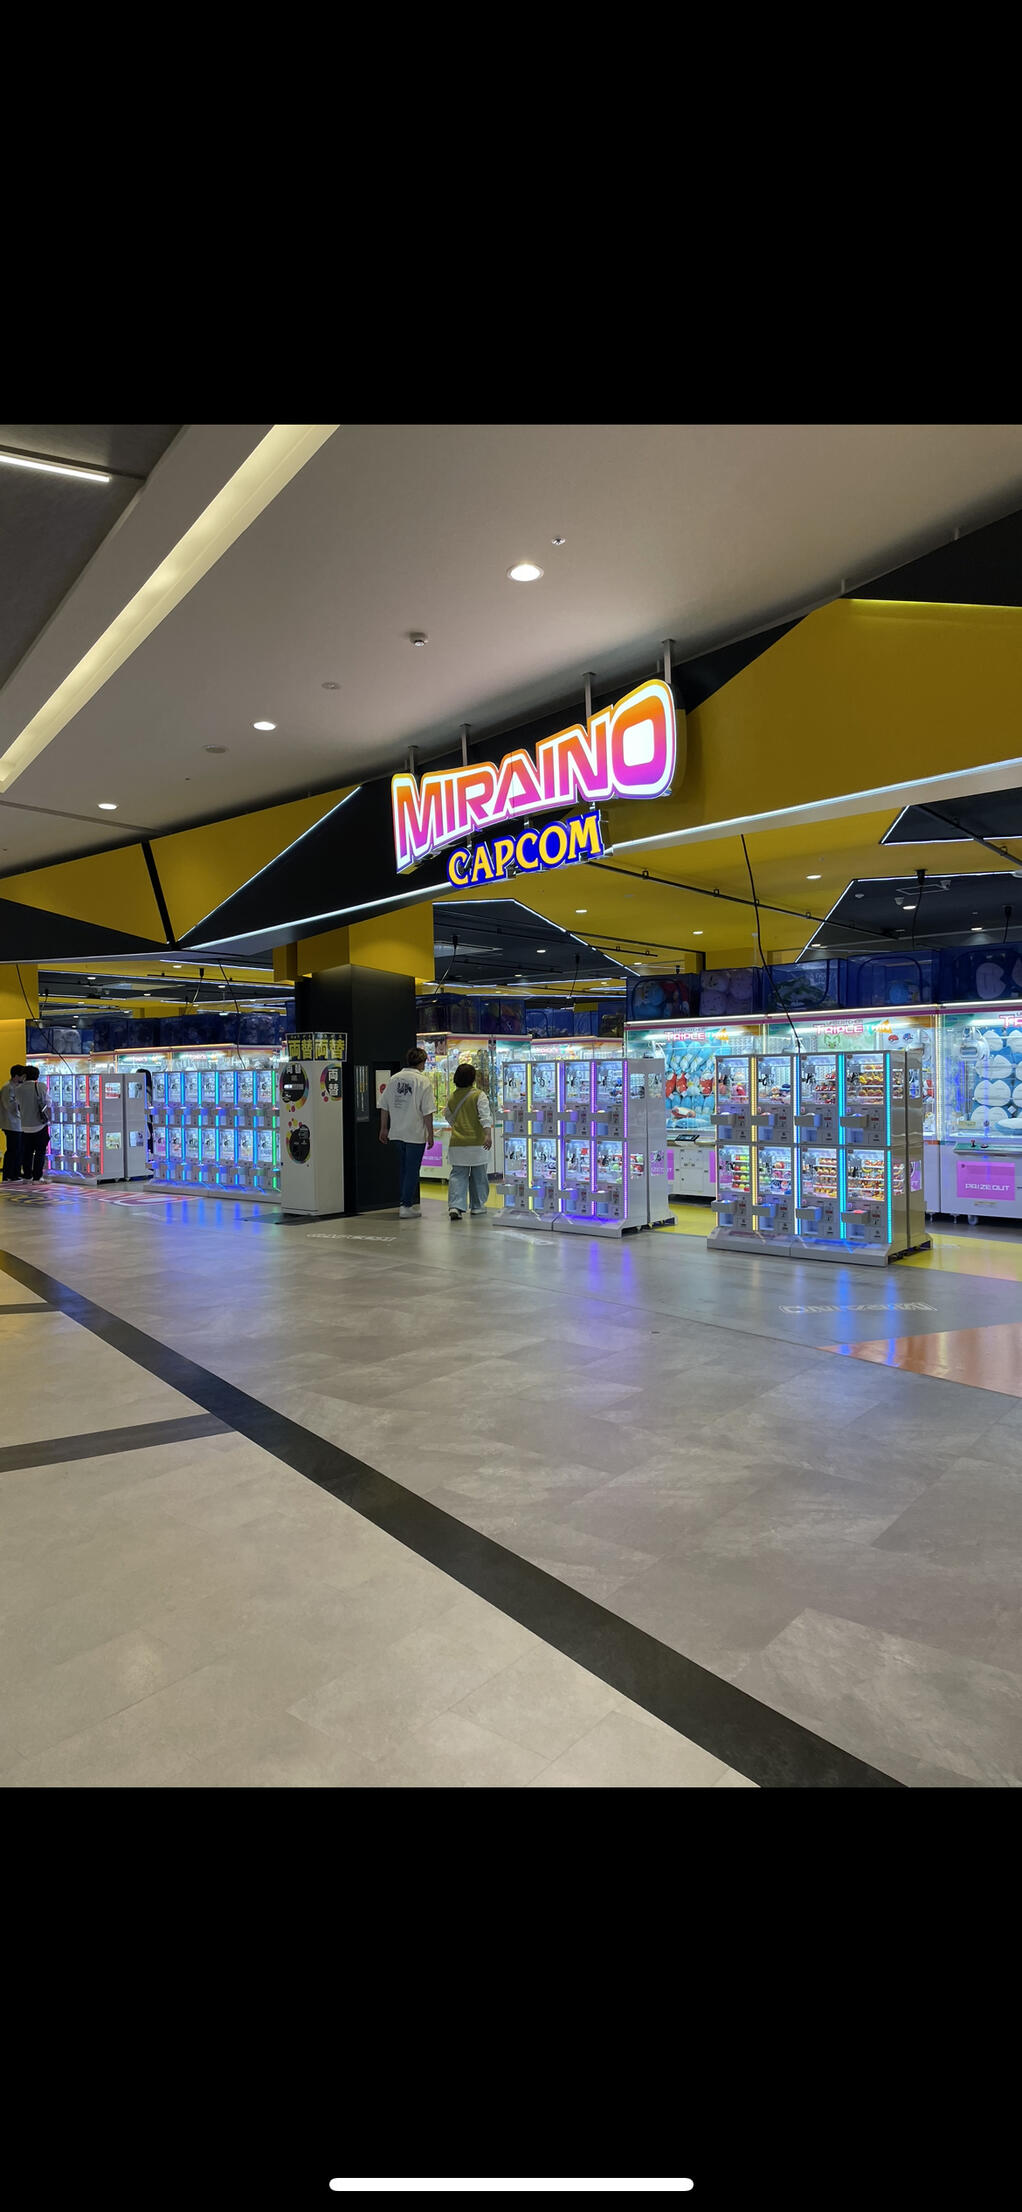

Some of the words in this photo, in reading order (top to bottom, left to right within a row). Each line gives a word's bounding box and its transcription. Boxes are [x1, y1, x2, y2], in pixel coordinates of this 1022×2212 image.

[394, 690, 670, 866] MIRAINO
[448, 814, 602, 886] CAPCOM
[314, 1039, 345, 1059] 両替
